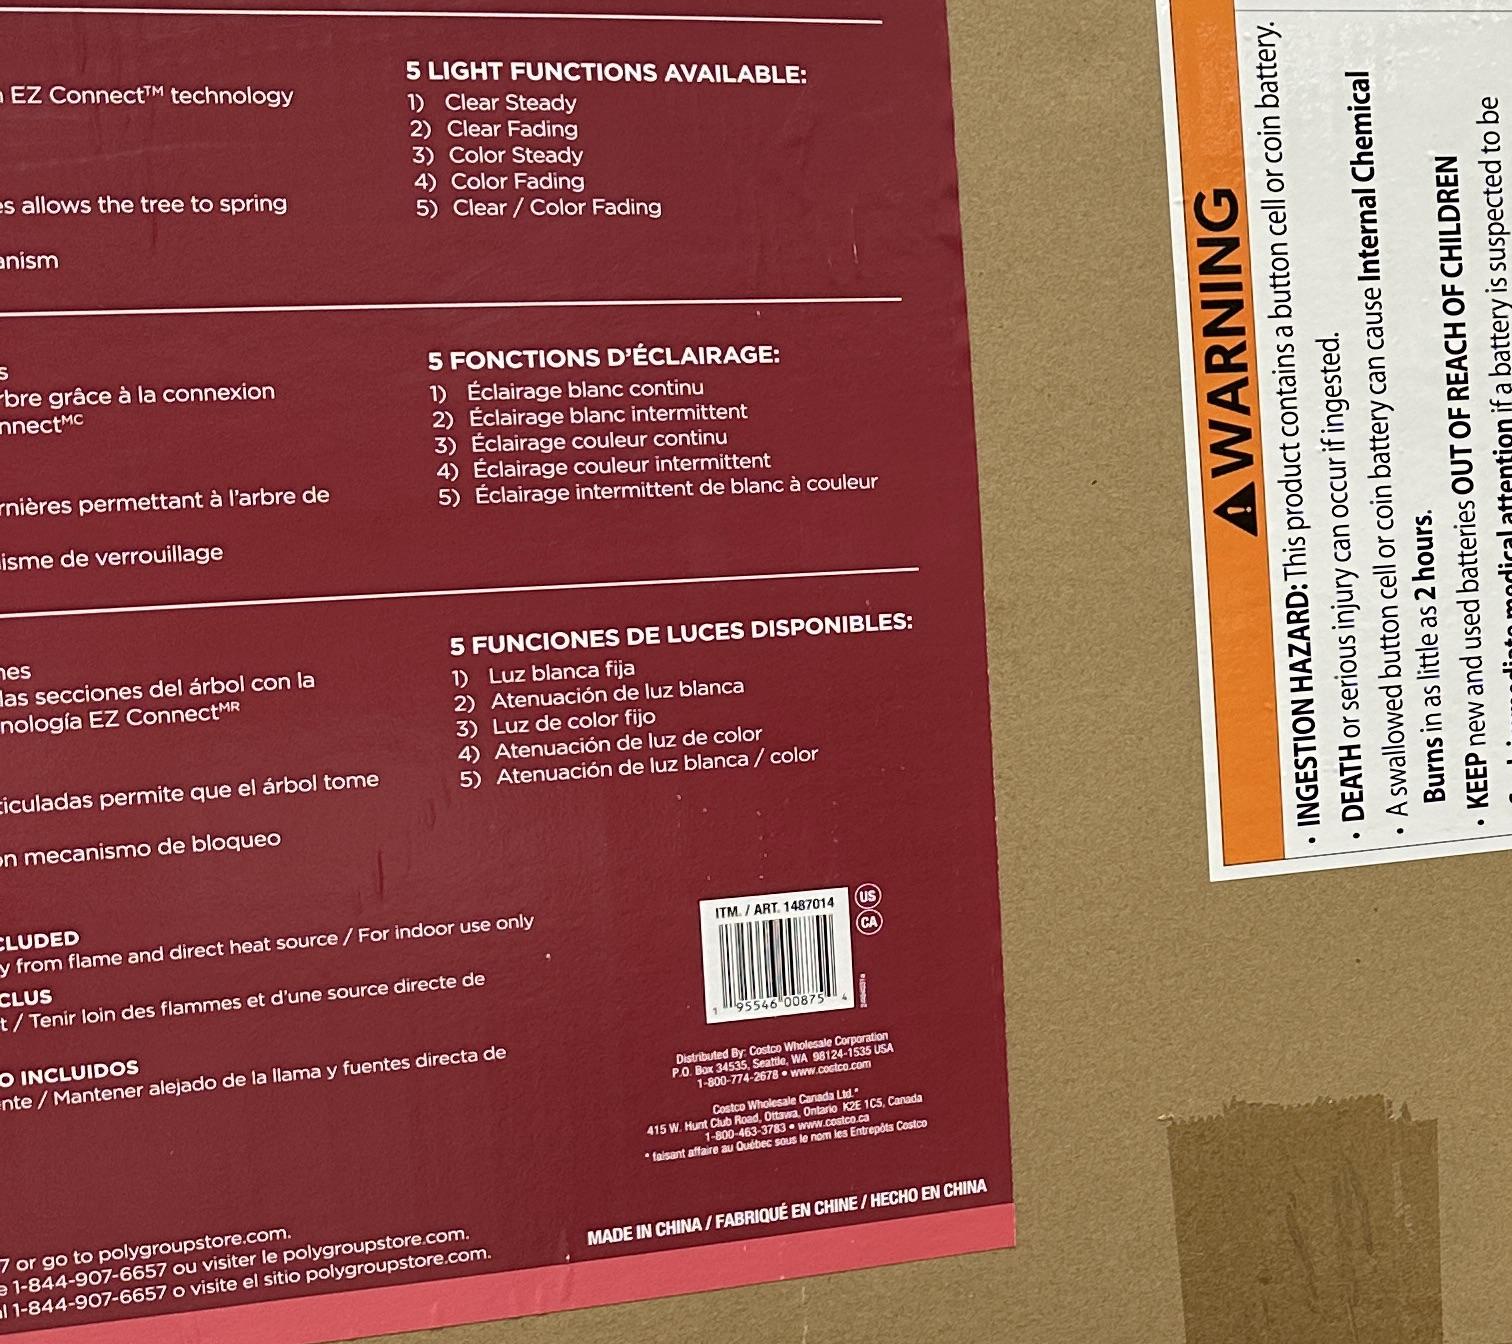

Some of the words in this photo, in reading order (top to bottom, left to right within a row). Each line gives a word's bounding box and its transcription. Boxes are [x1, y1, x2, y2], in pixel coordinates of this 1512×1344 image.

[407, 61, 420, 80] 5
[429, 62, 503, 80] LIGHT
[511, 62, 657, 82] FUNCTIONS
[665, 64, 806, 83] AVAILABLE:
[1254, 22, 1282, 108] battery.
[11, 87, 42, 104] EZ
[171, 86, 293, 107] technology
[408, 94, 424, 112] 1)
[445, 94, 499, 110] Clear
[506, 94, 576, 114] Steady
[411, 120, 431, 139] 2)
[448, 120, 501, 137] Clear
[508, 120, 577, 140] Fading
[1257, 116, 1283, 164] coin
[413, 147, 434, 166] 3)
[449, 146, 506, 163] Color
[512, 146, 583, 166] Steady
[415, 173, 436, 192] 4)
[452, 173, 508, 189] Color
[515, 172, 584, 192] Fading
[1266, 169, 1284, 192] or
[21, 196, 92, 215] allows
[98, 196, 134, 213] the
[141, 196, 184, 213] tree
[191, 196, 213, 212] to
[220, 194, 286, 215] spring
[417, 200, 438, 218] 5)
[454, 199, 507, 216] Clear
[513, 197, 524, 218] /
[530, 198, 586, 215] Color
[593, 199, 661, 218] Fading
[1260, 200, 1287, 235] cell
[1435, 157, 1463, 277] CHILDREN
[1267, 243, 1292, 318] button
[1442, 284, 1465, 316] OF
[1195, 189, 1255, 478] WARNING
[1276, 326, 1293, 337] a
[429, 352, 443, 370] 5
[450, 349, 600, 369] FONCTIONS
[608, 343, 779, 366] D’ÉCLAIRAGE:
[1444, 322, 1469, 401] REACH
[1272, 344, 1299, 436] contains
[1448, 408, 1473, 440] OF
[1277, 442, 1311, 530] product
[1449, 445, 1475, 495] OUT
[1282, 537, 1307, 580] This
[1454, 501, 1479, 593] batteries
[451, 638, 465, 655] 5
[473, 629, 619, 654] FUNCIONES
[627, 627, 660, 645] DE
[667, 622, 744, 643] LUCES
[752, 613, 912, 638] DISPONIBLES:
[1286, 585, 1314, 693] HAZARD:
[1456, 600, 1481, 649] used
[1459, 656, 1483, 695] and
[1468, 702, 1486, 746] new
[1291, 698, 1320, 826] INGESTION
[1465, 753, 1488, 809] KEEP
[716, 906, 742, 919] ITM.
[745, 905, 750, 915] /
[784, 897, 834, 912] 1487014
[859, 889, 876, 902] US
[860, 916, 878, 929] CA
[736, 998, 778, 1012] 95546
[784, 993, 825, 1008] 00875
[676, 1049, 728, 1064] Distributed
[731, 1048, 746, 1059] By:
[749, 1045, 782, 1056] Costco
[784, 1038, 832, 1051] Wholesale
[835, 1032, 888, 1046] Corporation
[588, 1226, 633, 1245] MADE
[637, 1224, 652, 1239] IN
[656, 1218, 702, 1236] CHINA
[705, 1215, 712, 1230] /
[716, 1203, 788, 1228] FABRIQUÉ
[792, 1202, 810, 1218] EN
[815, 1196, 858, 1215] CHINE
[861, 1194, 867, 1209] /
[871, 1188, 918, 1207] HECHO
[922, 1185, 940, 1200] EN
[944, 1179, 987, 1197] CHINA
